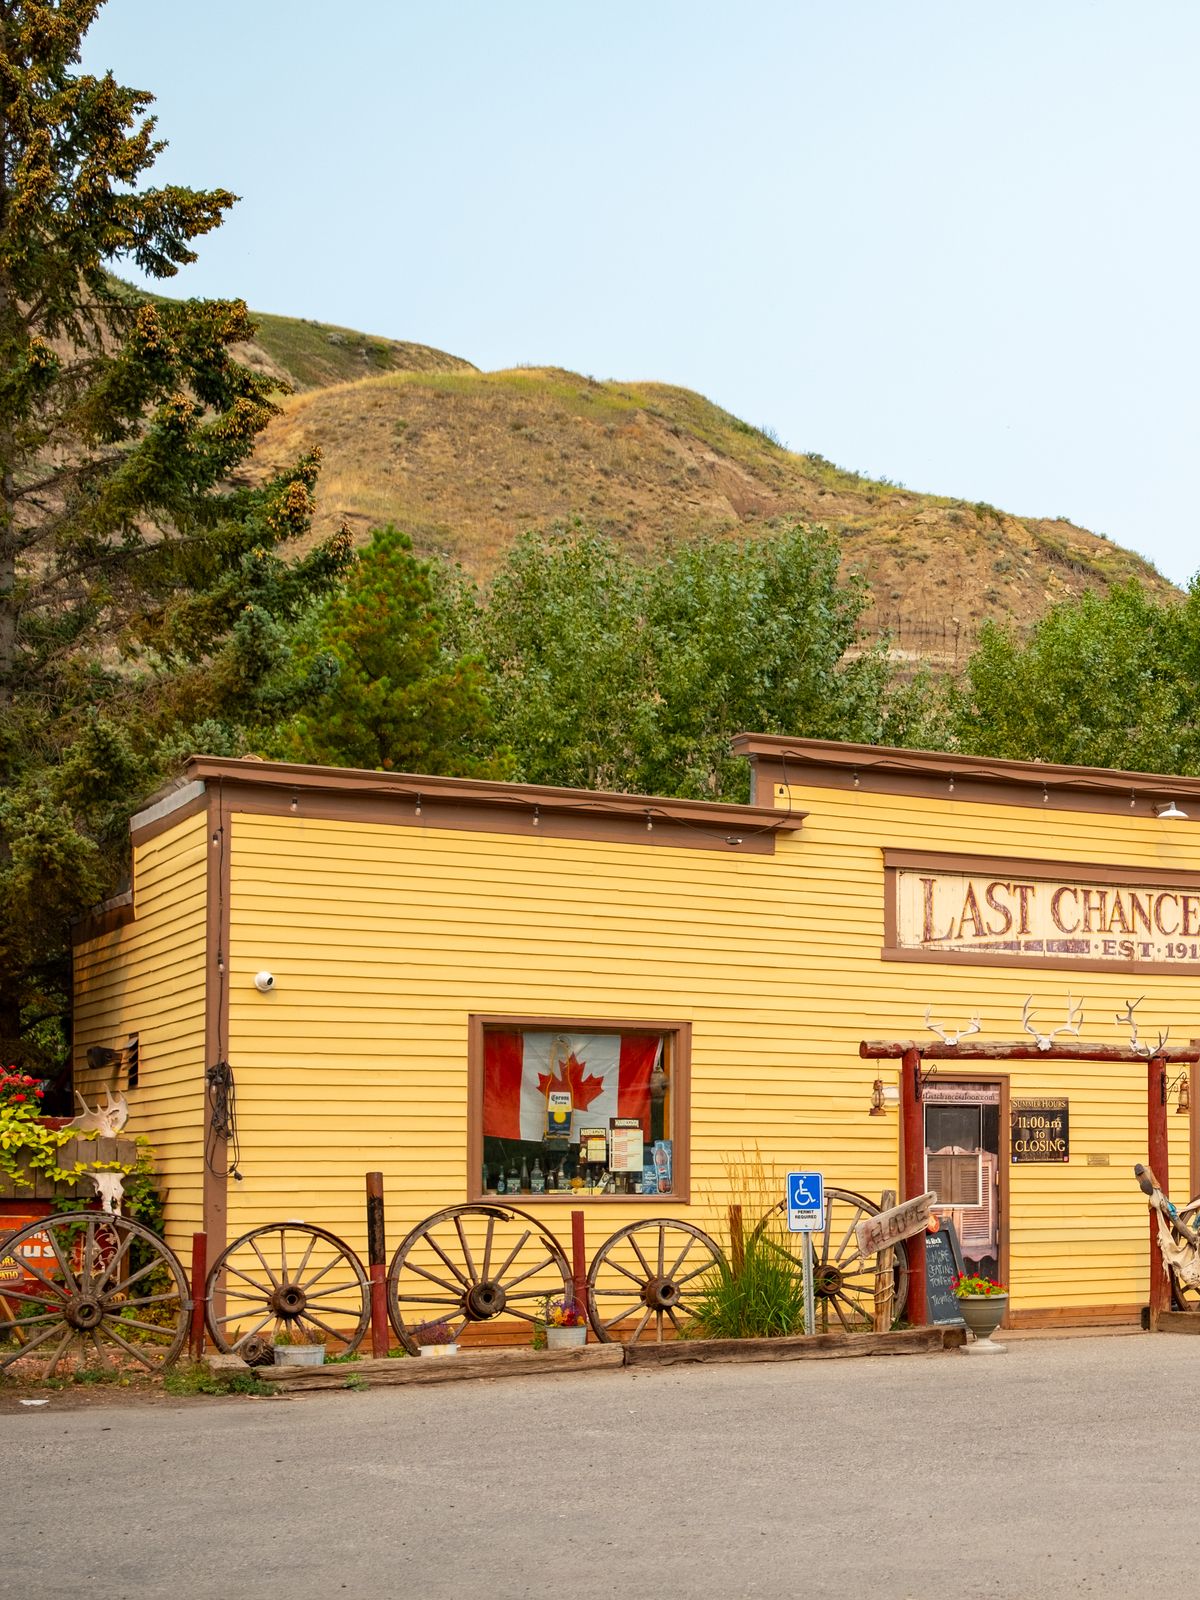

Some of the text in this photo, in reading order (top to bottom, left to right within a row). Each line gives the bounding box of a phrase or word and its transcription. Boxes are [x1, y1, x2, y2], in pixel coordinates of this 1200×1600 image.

[919, 878, 1036, 943] LAST
[1018, 1116, 1062, 1128] 11:00am
[1036, 1130, 1046, 1139] to
[1015, 1140, 1066, 1152] CLOSING
